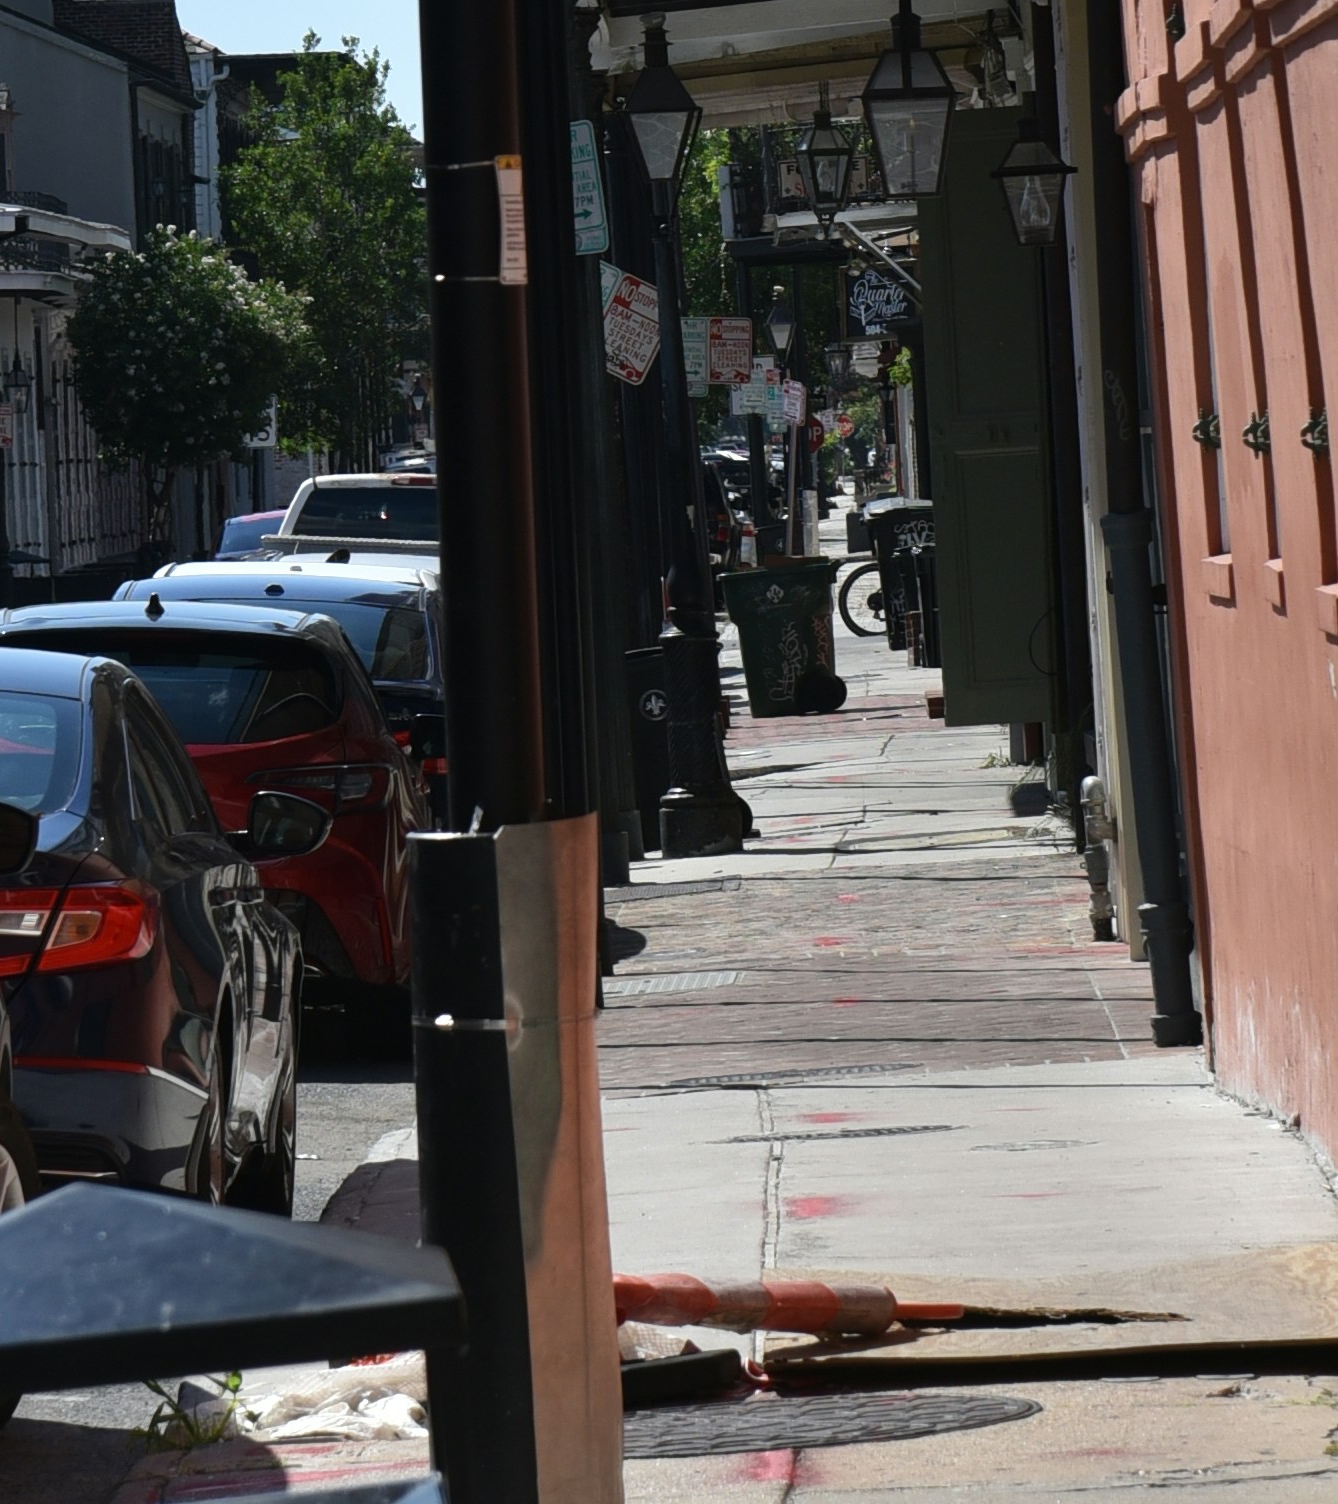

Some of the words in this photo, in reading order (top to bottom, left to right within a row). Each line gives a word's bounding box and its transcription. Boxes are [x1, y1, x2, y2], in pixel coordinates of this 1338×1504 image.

[617, 278, 637, 302] NO
[608, 327, 645, 350] STREET
[609, 317, 654, 345] TUESDAYS
[605, 338, 647, 363] LEANING
